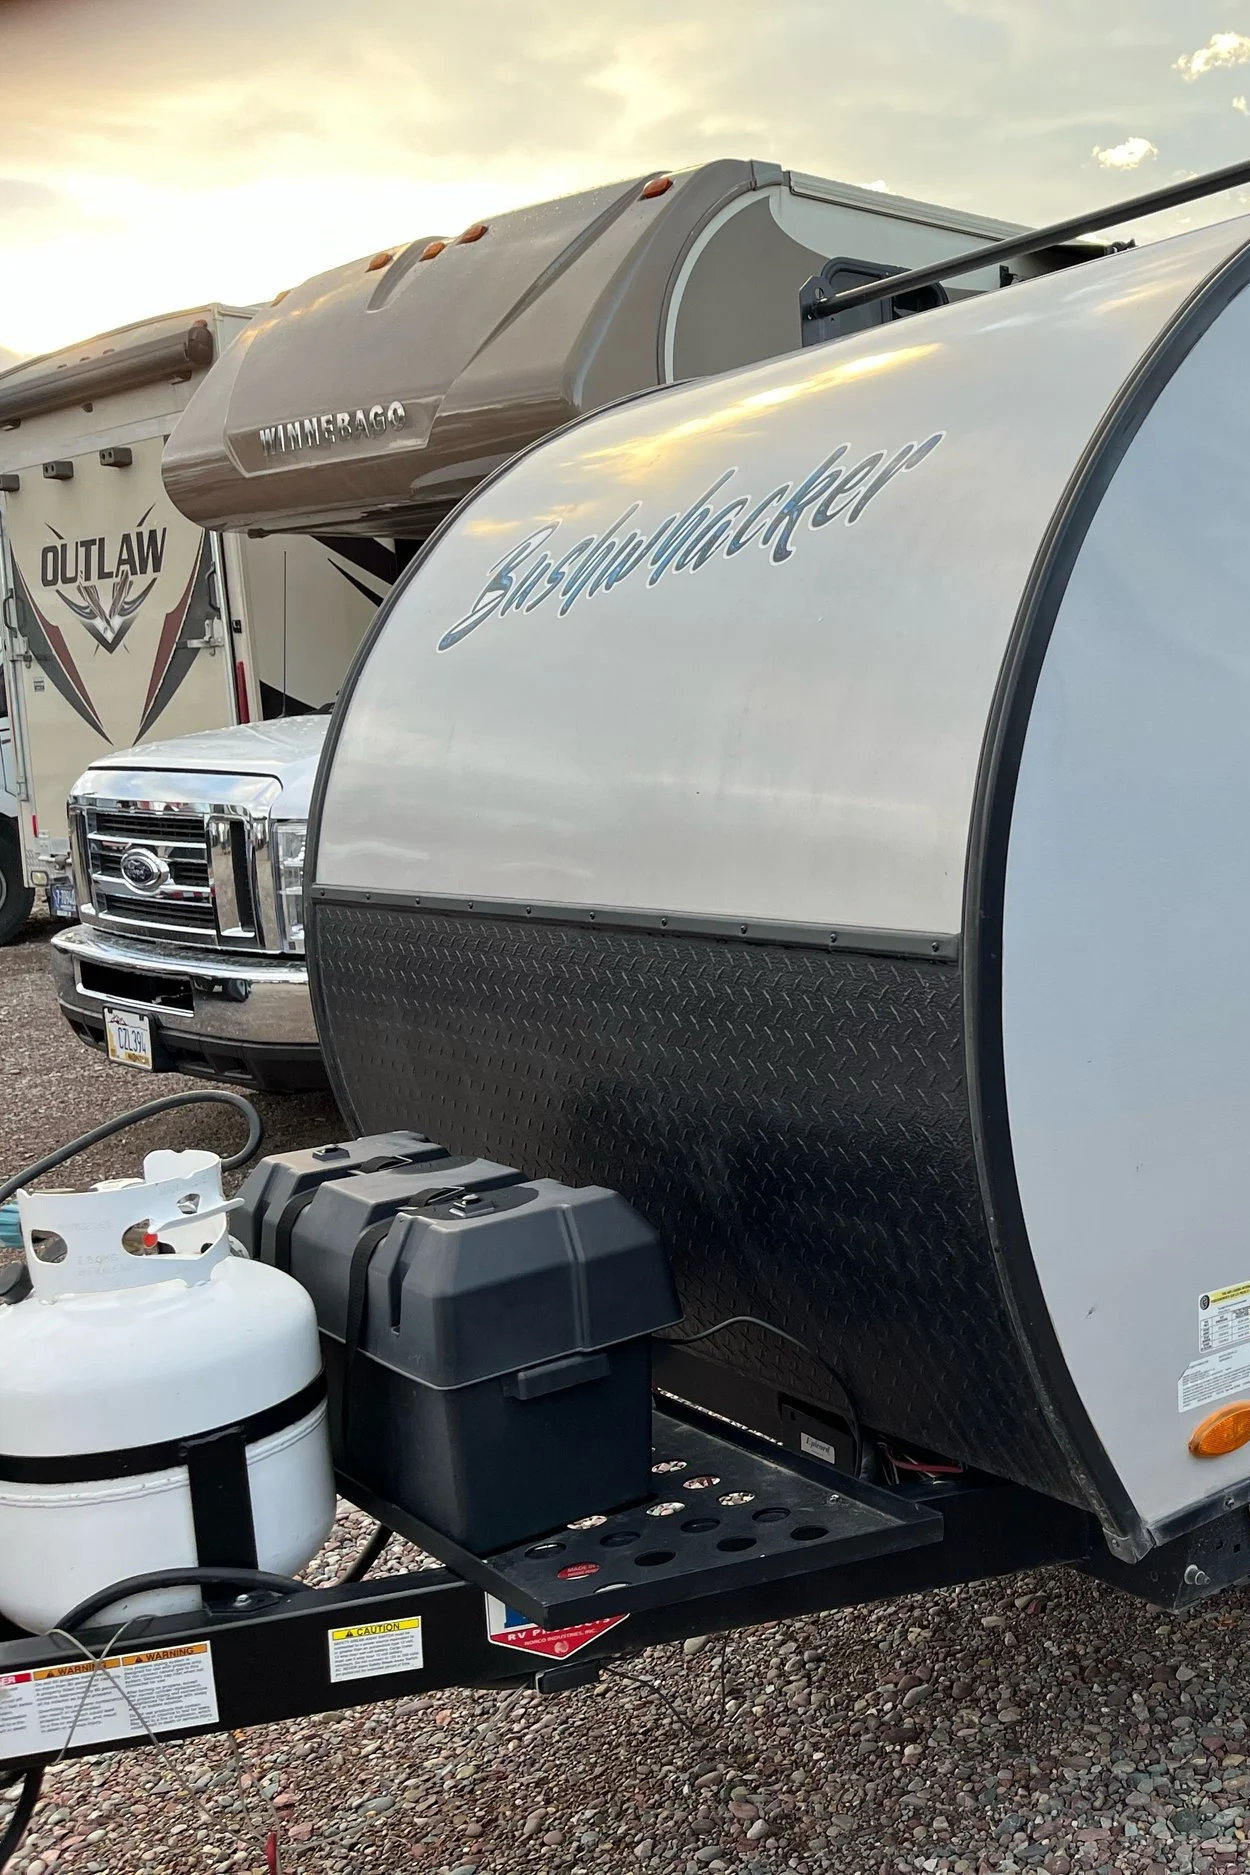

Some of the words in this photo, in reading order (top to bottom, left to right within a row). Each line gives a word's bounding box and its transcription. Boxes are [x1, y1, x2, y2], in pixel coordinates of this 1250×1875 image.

[259, 400, 406, 456] WINNEBAGO
[41, 526, 167, 588] OUTLAW
[436, 431, 947, 653] Bushwhacker
[356, 1622, 400, 1637] CAUTION
[507, 1630, 527, 1641] RV
[145, 1646, 195, 1662] WARNING
